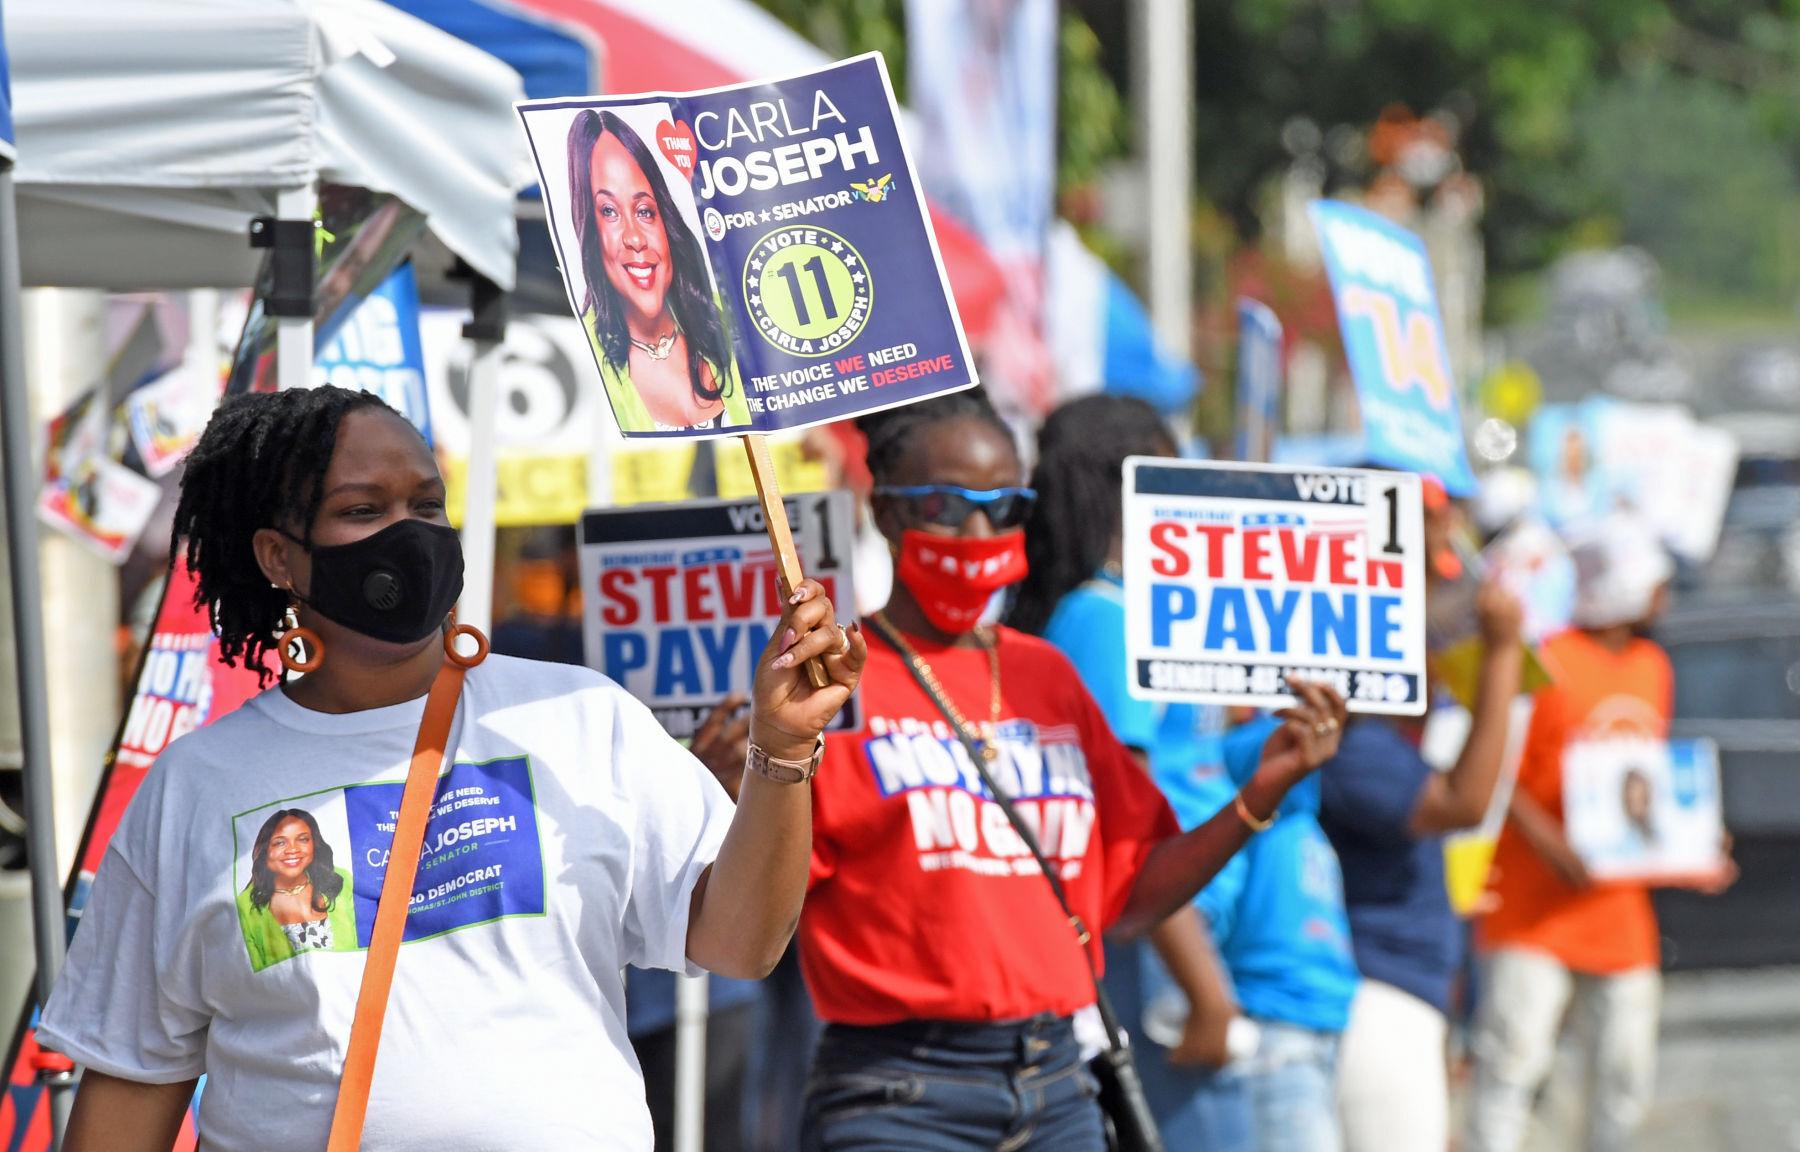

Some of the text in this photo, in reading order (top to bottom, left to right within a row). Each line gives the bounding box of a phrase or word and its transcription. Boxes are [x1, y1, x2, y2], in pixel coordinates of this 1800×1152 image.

[662, 136, 692, 151] THANK
[694, 89, 847, 151] CARLA
[673, 154, 692, 169] YOU
[700, 125, 880, 200] JOSEPH
[725, 190, 853, 230] FOR SENATOR
[764, 230, 818, 253] VOTE
[776, 255, 838, 326] 11
[760, 296, 868, 353] CARLA JOSEPH
[746, 354, 954, 413] THE CHANGE WE DESERVE
[751, 342, 918, 393] THE VOICE WE NEED
[727, 498, 839, 569] VOE 1
[1293, 474, 1404, 555] VOTE 1
[1150, 522, 1404, 589] STEVEN
[600, 560, 838, 627] STEV
[1151, 584, 1404, 660] PAYNE
[603, 622, 774, 696] PAY
[869, 731, 960, 796] NO
[376, 823, 396, 833] THE
[437, 804, 453, 816] WE
[454, 796, 500, 810] DESERVE
[440, 787, 483, 804] WE NEED
[906, 789, 979, 853] NO
[367, 815, 517, 868] CAA JOSEPH
[425, 842, 478, 871] SENATOR
[408, 864, 502, 905] 20 DEMOCRAT
[469, 881, 505, 898] DISTRICT
